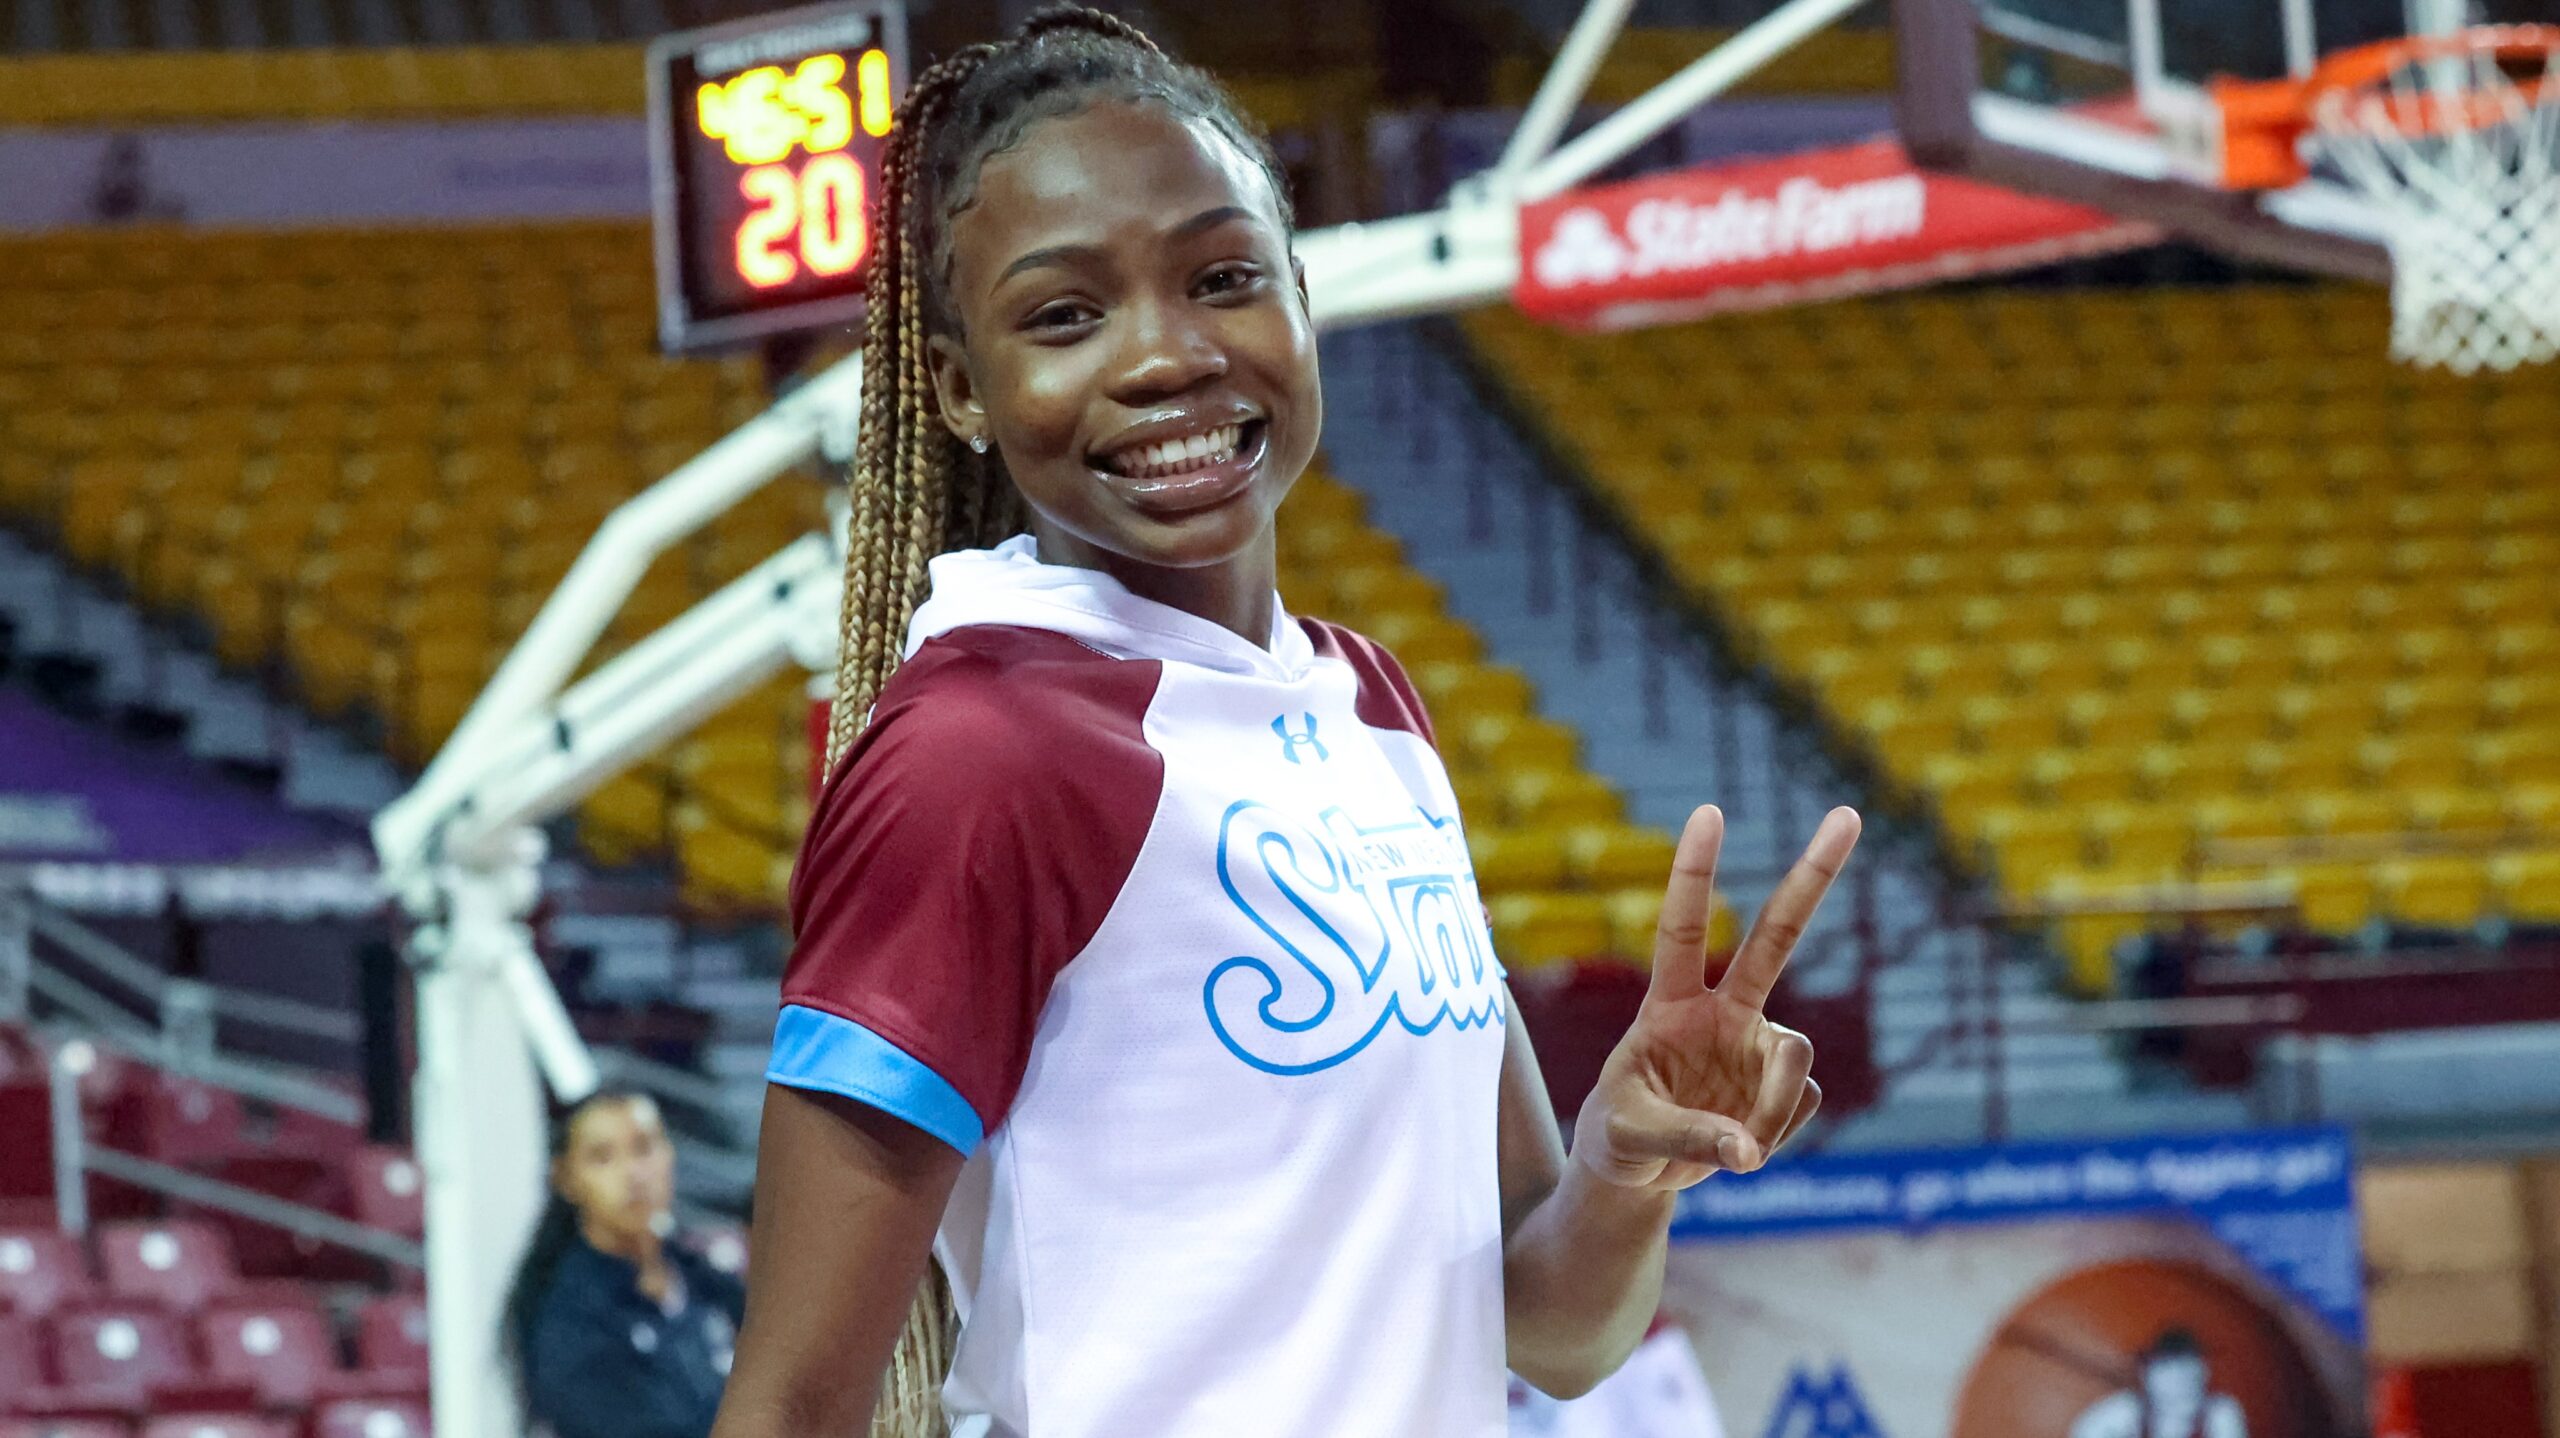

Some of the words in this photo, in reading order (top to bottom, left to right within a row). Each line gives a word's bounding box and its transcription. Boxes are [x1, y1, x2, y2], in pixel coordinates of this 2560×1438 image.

[736, 152, 868, 289] 20
[1350, 842, 1406, 874] NEW
[1203, 799, 1506, 1076] Stat
